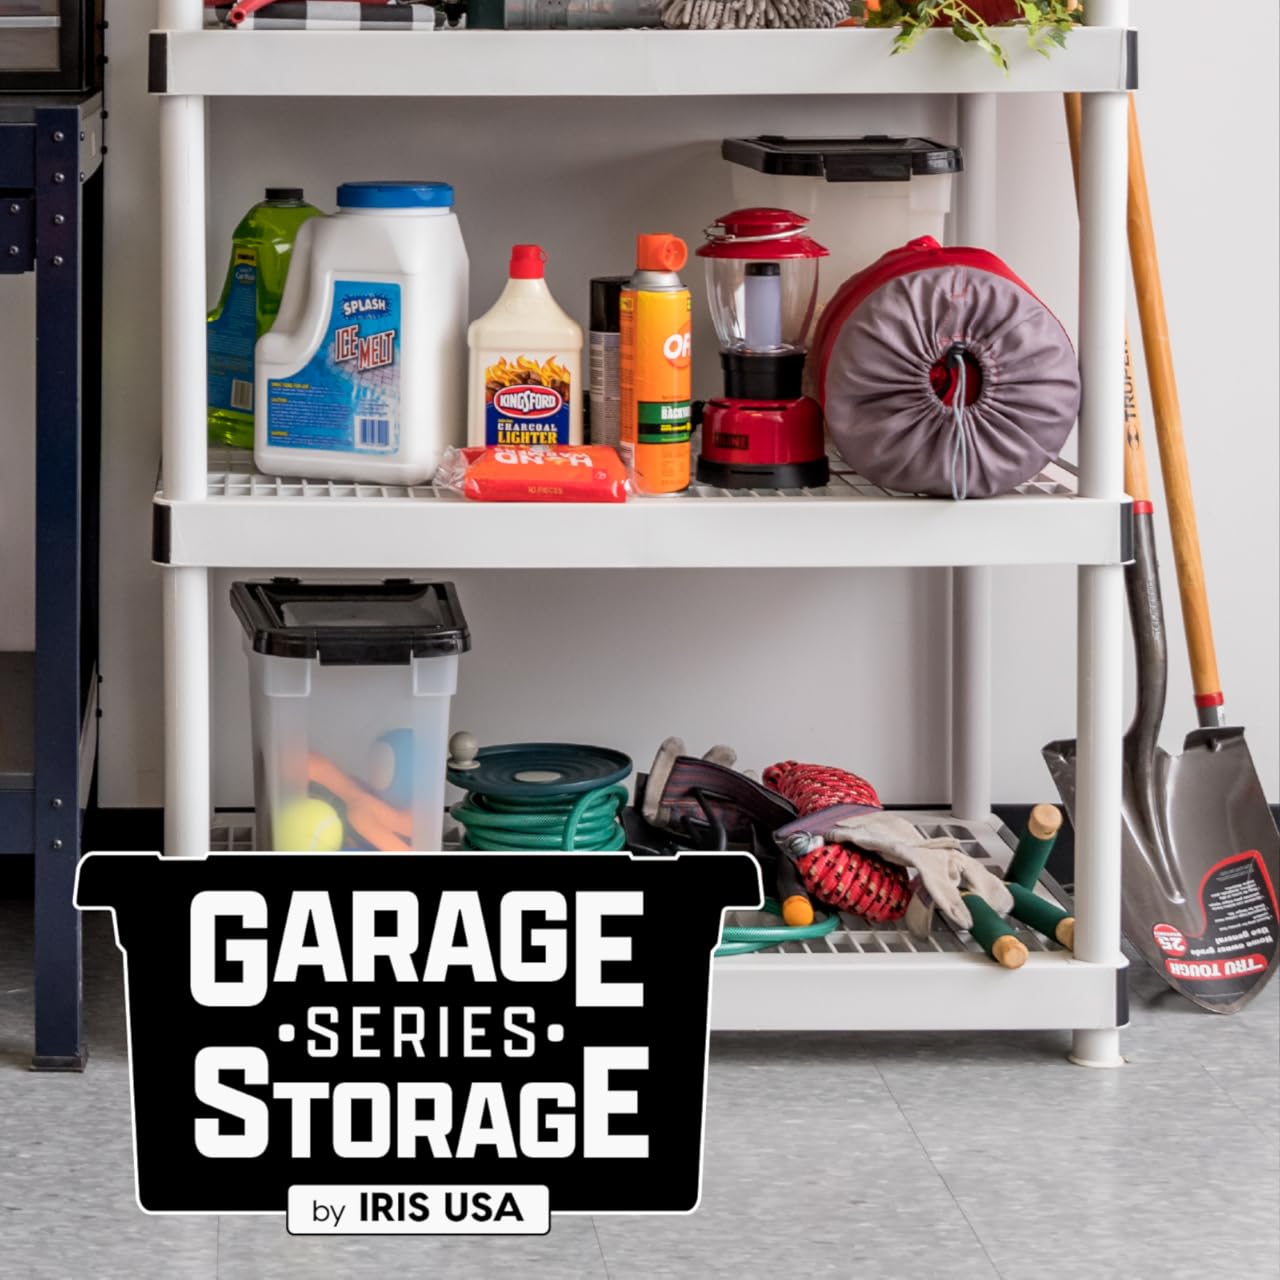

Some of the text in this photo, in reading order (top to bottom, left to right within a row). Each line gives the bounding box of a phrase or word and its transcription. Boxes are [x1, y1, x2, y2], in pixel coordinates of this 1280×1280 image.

[343, 298, 386, 316] SPLASH
[335, 324, 395, 371] ICE MELT
[500, 390, 556, 412] KINGSFORD
[497, 423, 558, 431] CHARCOAL
[498, 431, 558, 444] LIGHTER
[1159, 936, 1185, 951] 25
[1169, 959, 1264, 977] TRU TOUGH
